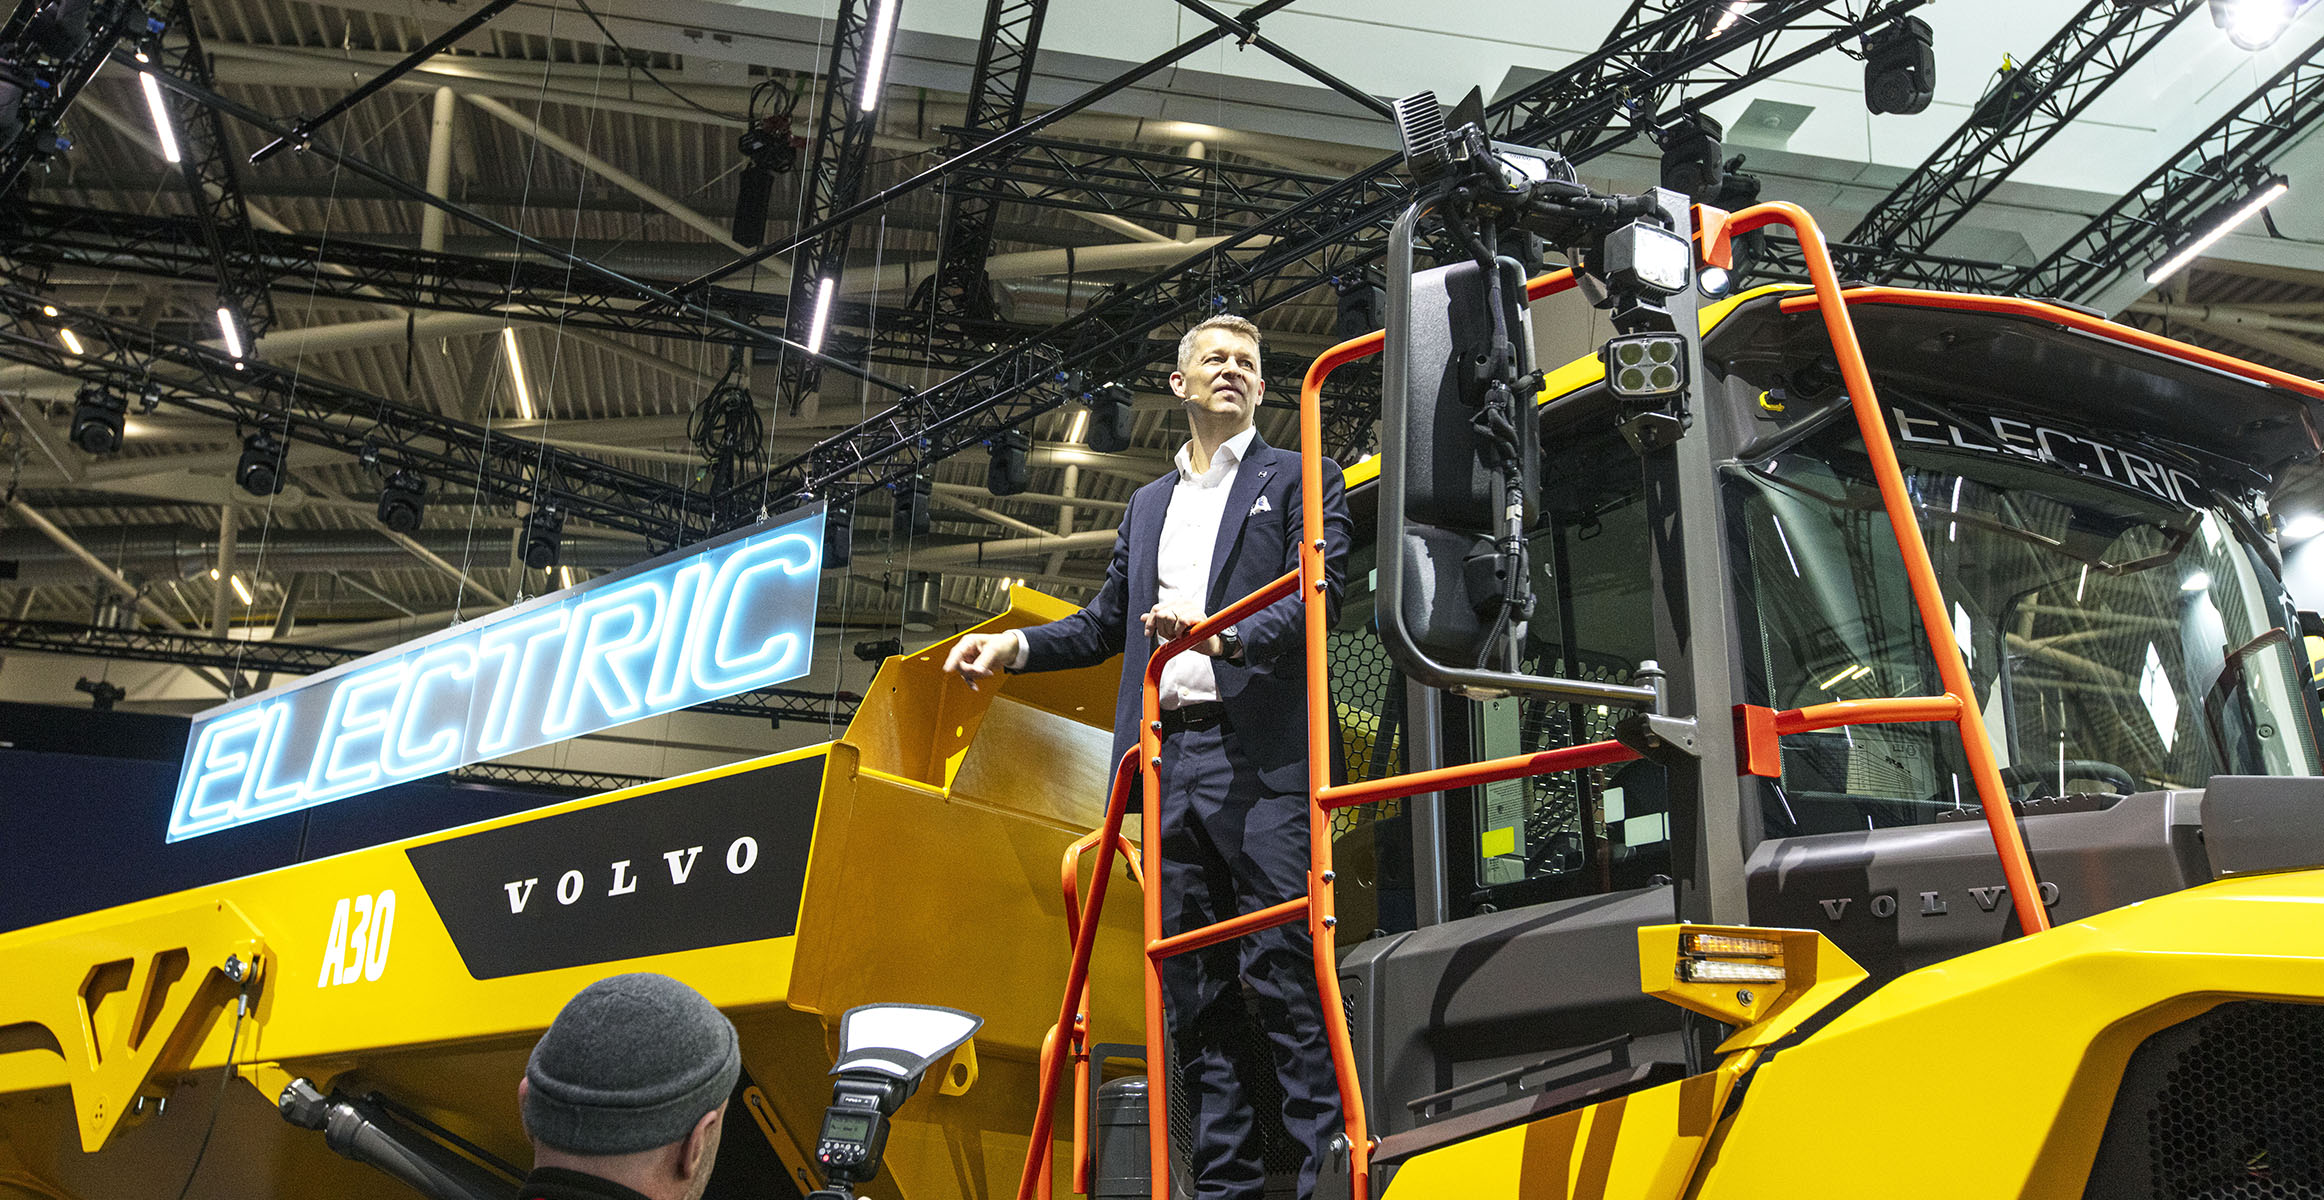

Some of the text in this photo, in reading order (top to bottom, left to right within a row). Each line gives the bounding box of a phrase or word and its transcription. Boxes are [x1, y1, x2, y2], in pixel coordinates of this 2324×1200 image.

[1892, 407, 2205, 511] ELECTRIC
[170, 532, 818, 838] ELECTRIC
[504, 836, 758, 914] VOLVO
[1819, 881, 2060, 921] VOLVO
[317, 889, 396, 988] A30
